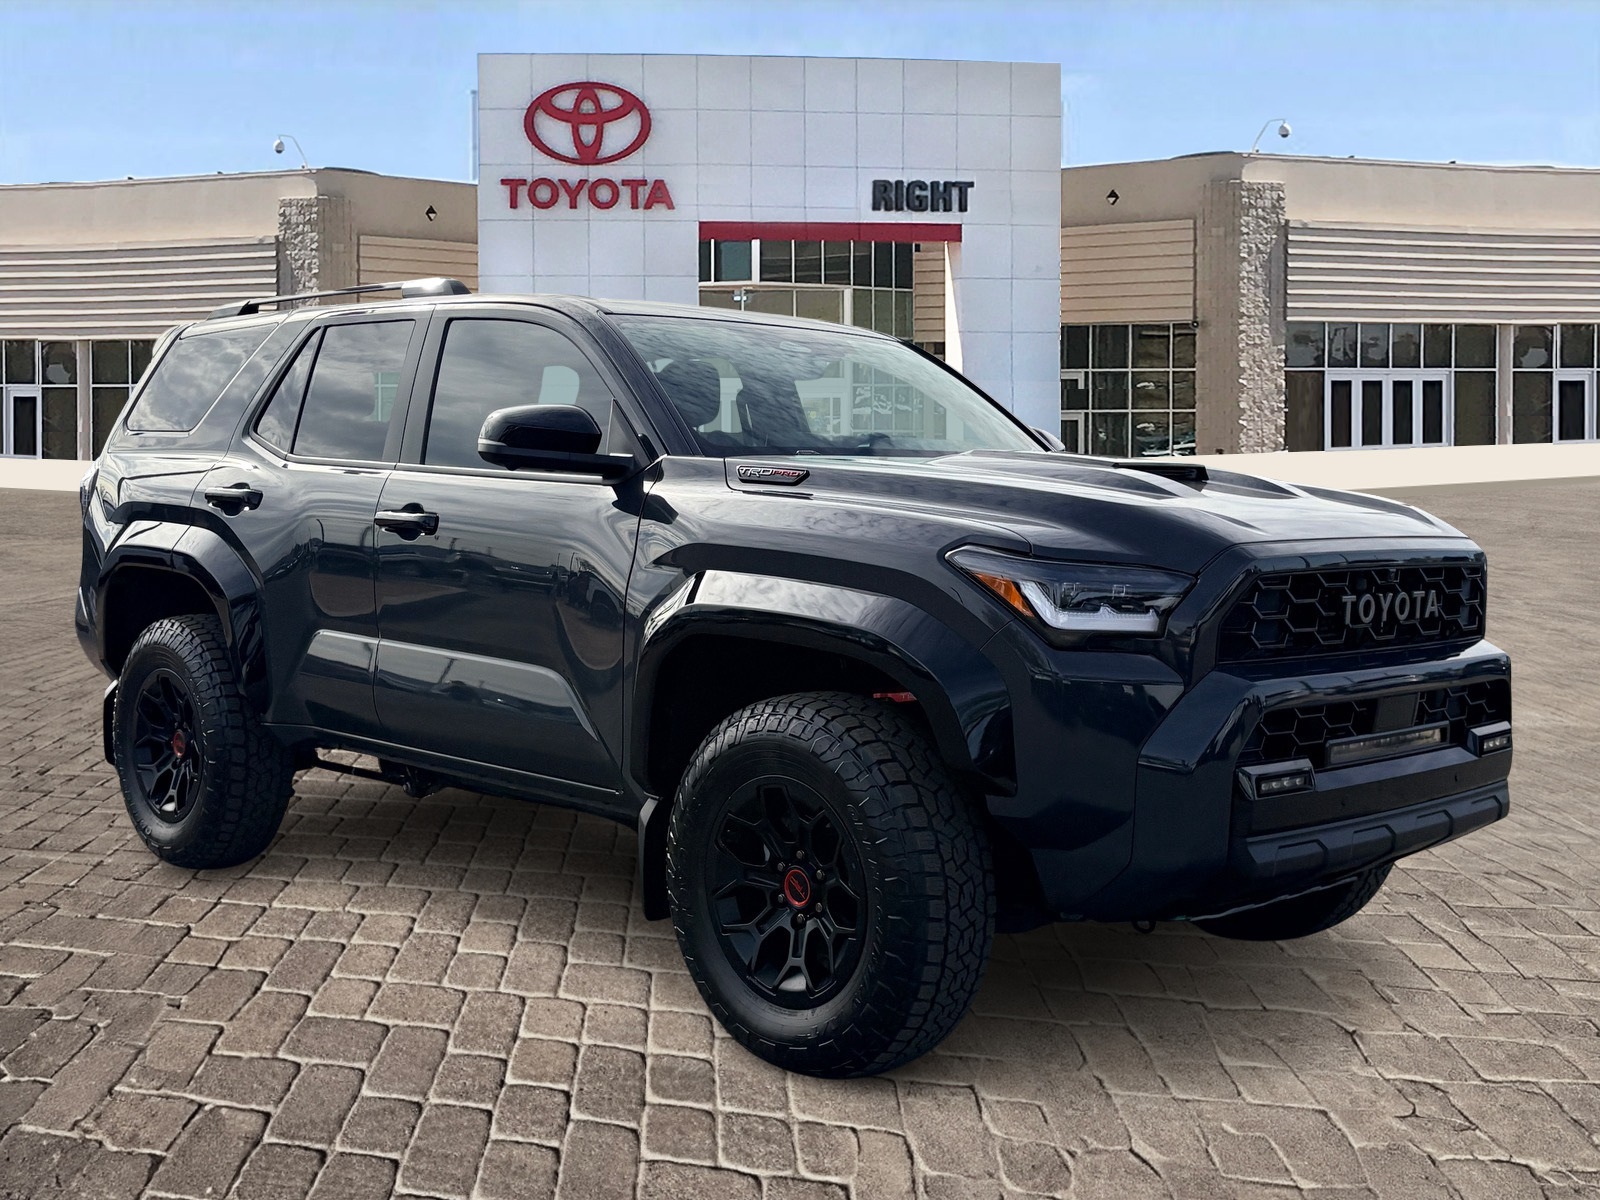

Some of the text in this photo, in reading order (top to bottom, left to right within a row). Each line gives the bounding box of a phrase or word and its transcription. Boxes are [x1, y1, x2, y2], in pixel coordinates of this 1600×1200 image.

[500, 178, 675, 210] TOYOTA
[871, 179, 975, 213] RIGHT
[739, 467, 801, 477] TRD PRO
[1342, 590, 1439, 625] TOYOTA
